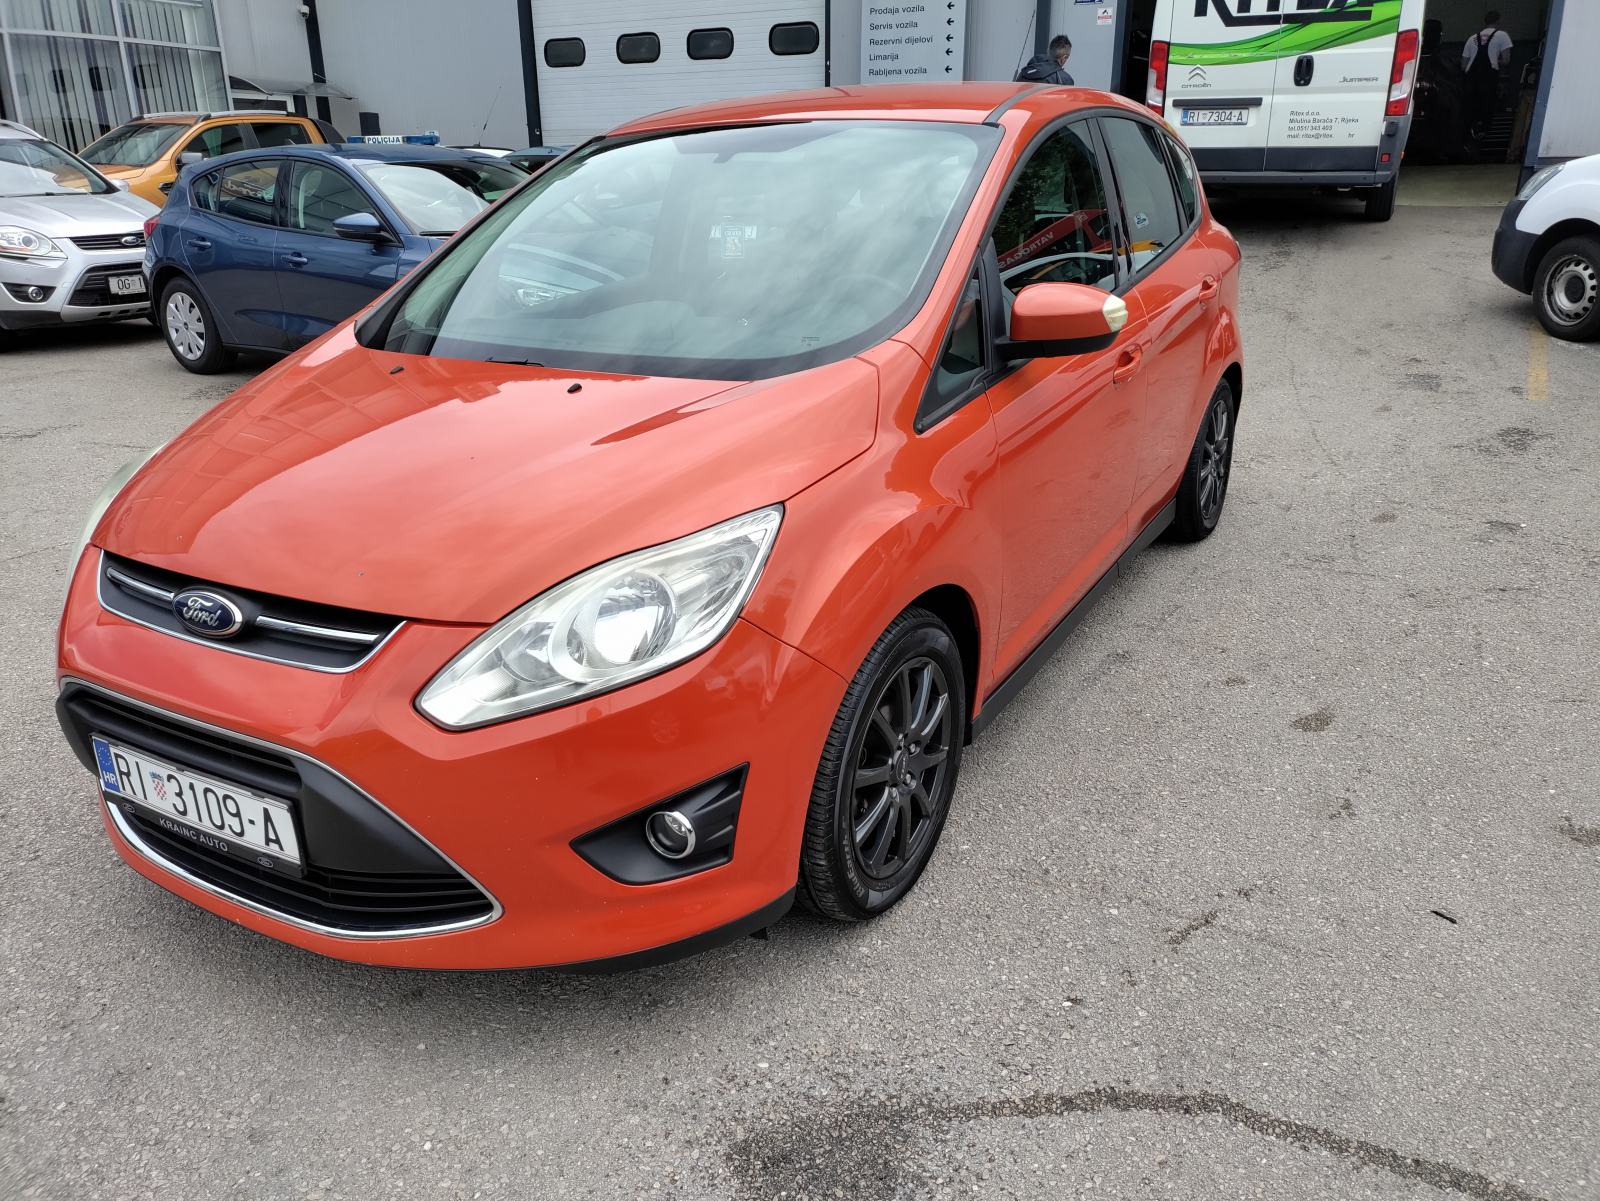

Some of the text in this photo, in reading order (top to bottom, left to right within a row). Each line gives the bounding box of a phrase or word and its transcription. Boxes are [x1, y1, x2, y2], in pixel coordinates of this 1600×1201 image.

[869, 4, 925, 15] Prodaja vozila
[869, 21, 918, 31] Servis vozila
[869, 35, 933, 46] Rezervni dijelovi
[869, 53, 899, 62] Limarija
[868, 66, 927, 77] Rabljena vozila
[1188, 111, 1200, 122] RI
[1207, 110, 1243, 122] 7304-A
[367, 136, 401, 144] POLICIJA
[117, 278, 131, 290] OG
[183, 596, 222, 627] Ford
[102, 770, 118, 786] HR
[113, 751, 285, 852] RI 3109-A
[159, 817, 228, 852] KRAINC AUTO
